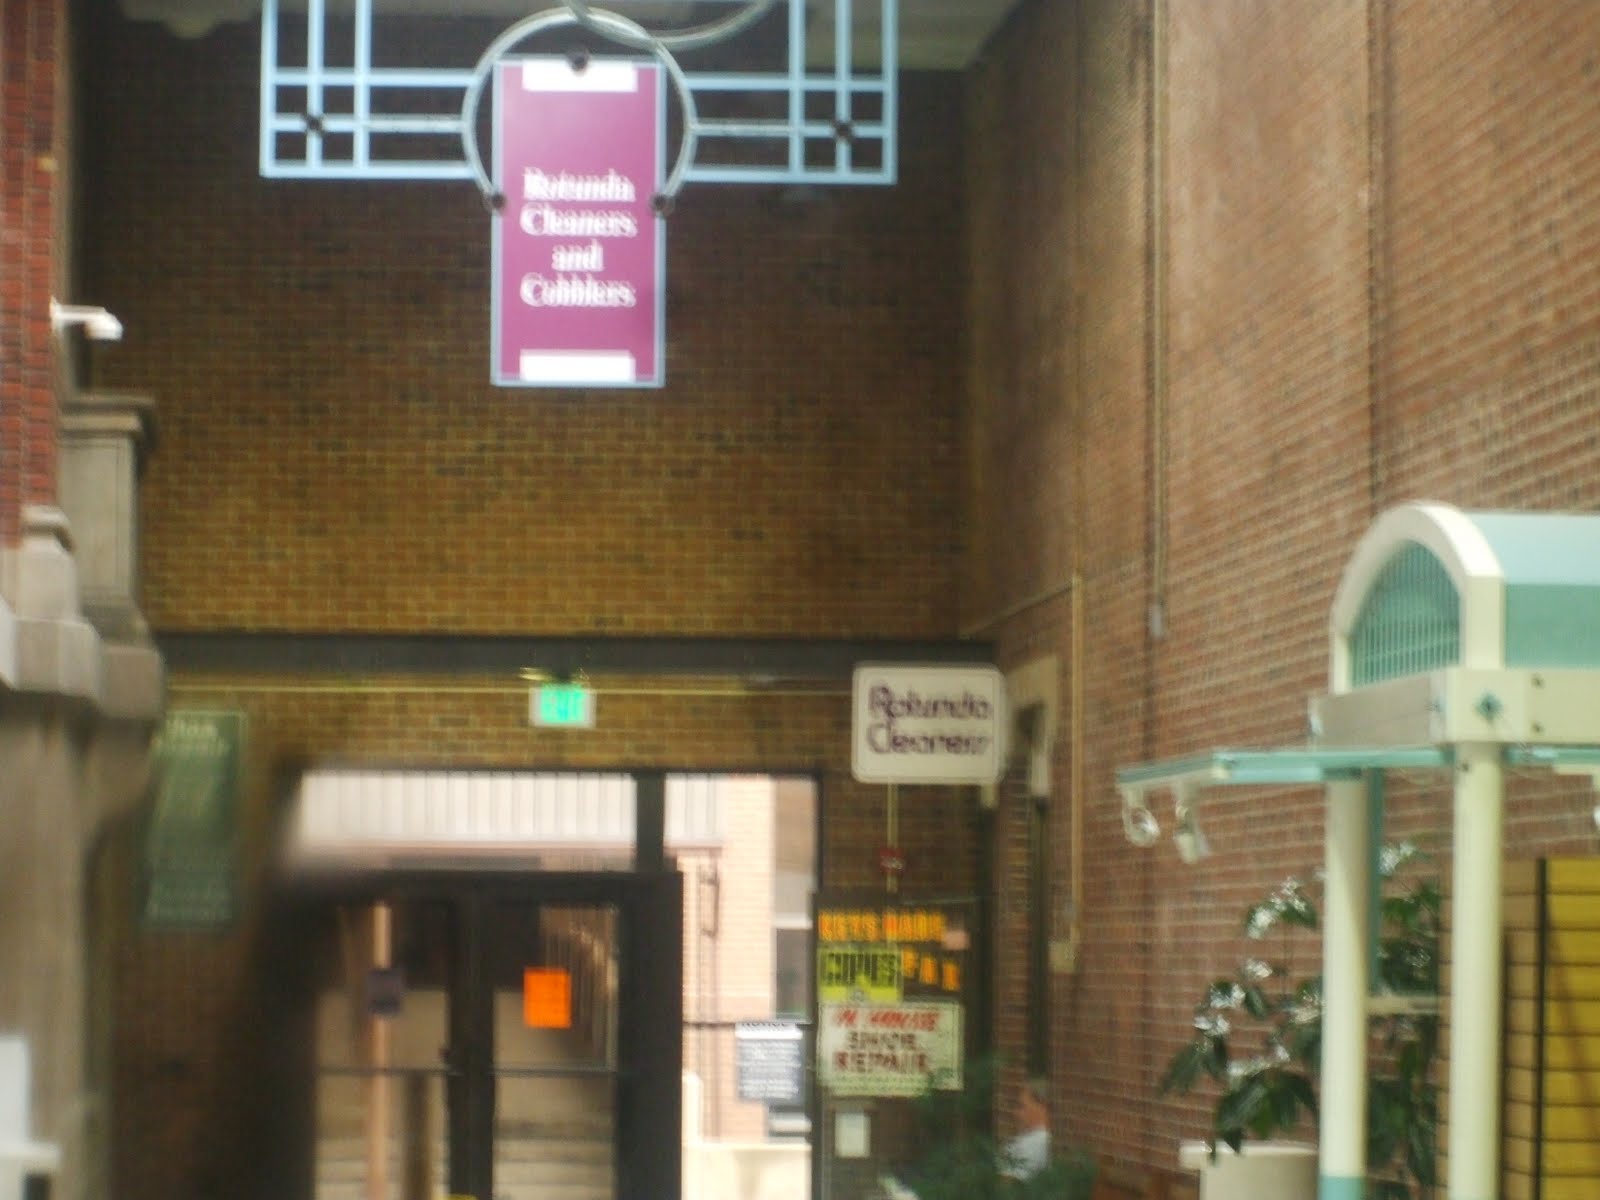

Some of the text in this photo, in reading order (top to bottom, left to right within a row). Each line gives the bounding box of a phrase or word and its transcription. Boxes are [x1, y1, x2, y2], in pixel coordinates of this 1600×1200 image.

[523, 168, 636, 202] Rotunda
[520, 204, 637, 237] Cleaners
[551, 239, 604, 272] and
[519, 273, 637, 308] Cobblers
[868, 683, 992, 721] Rotunda
[866, 721, 990, 755] Cleaners
